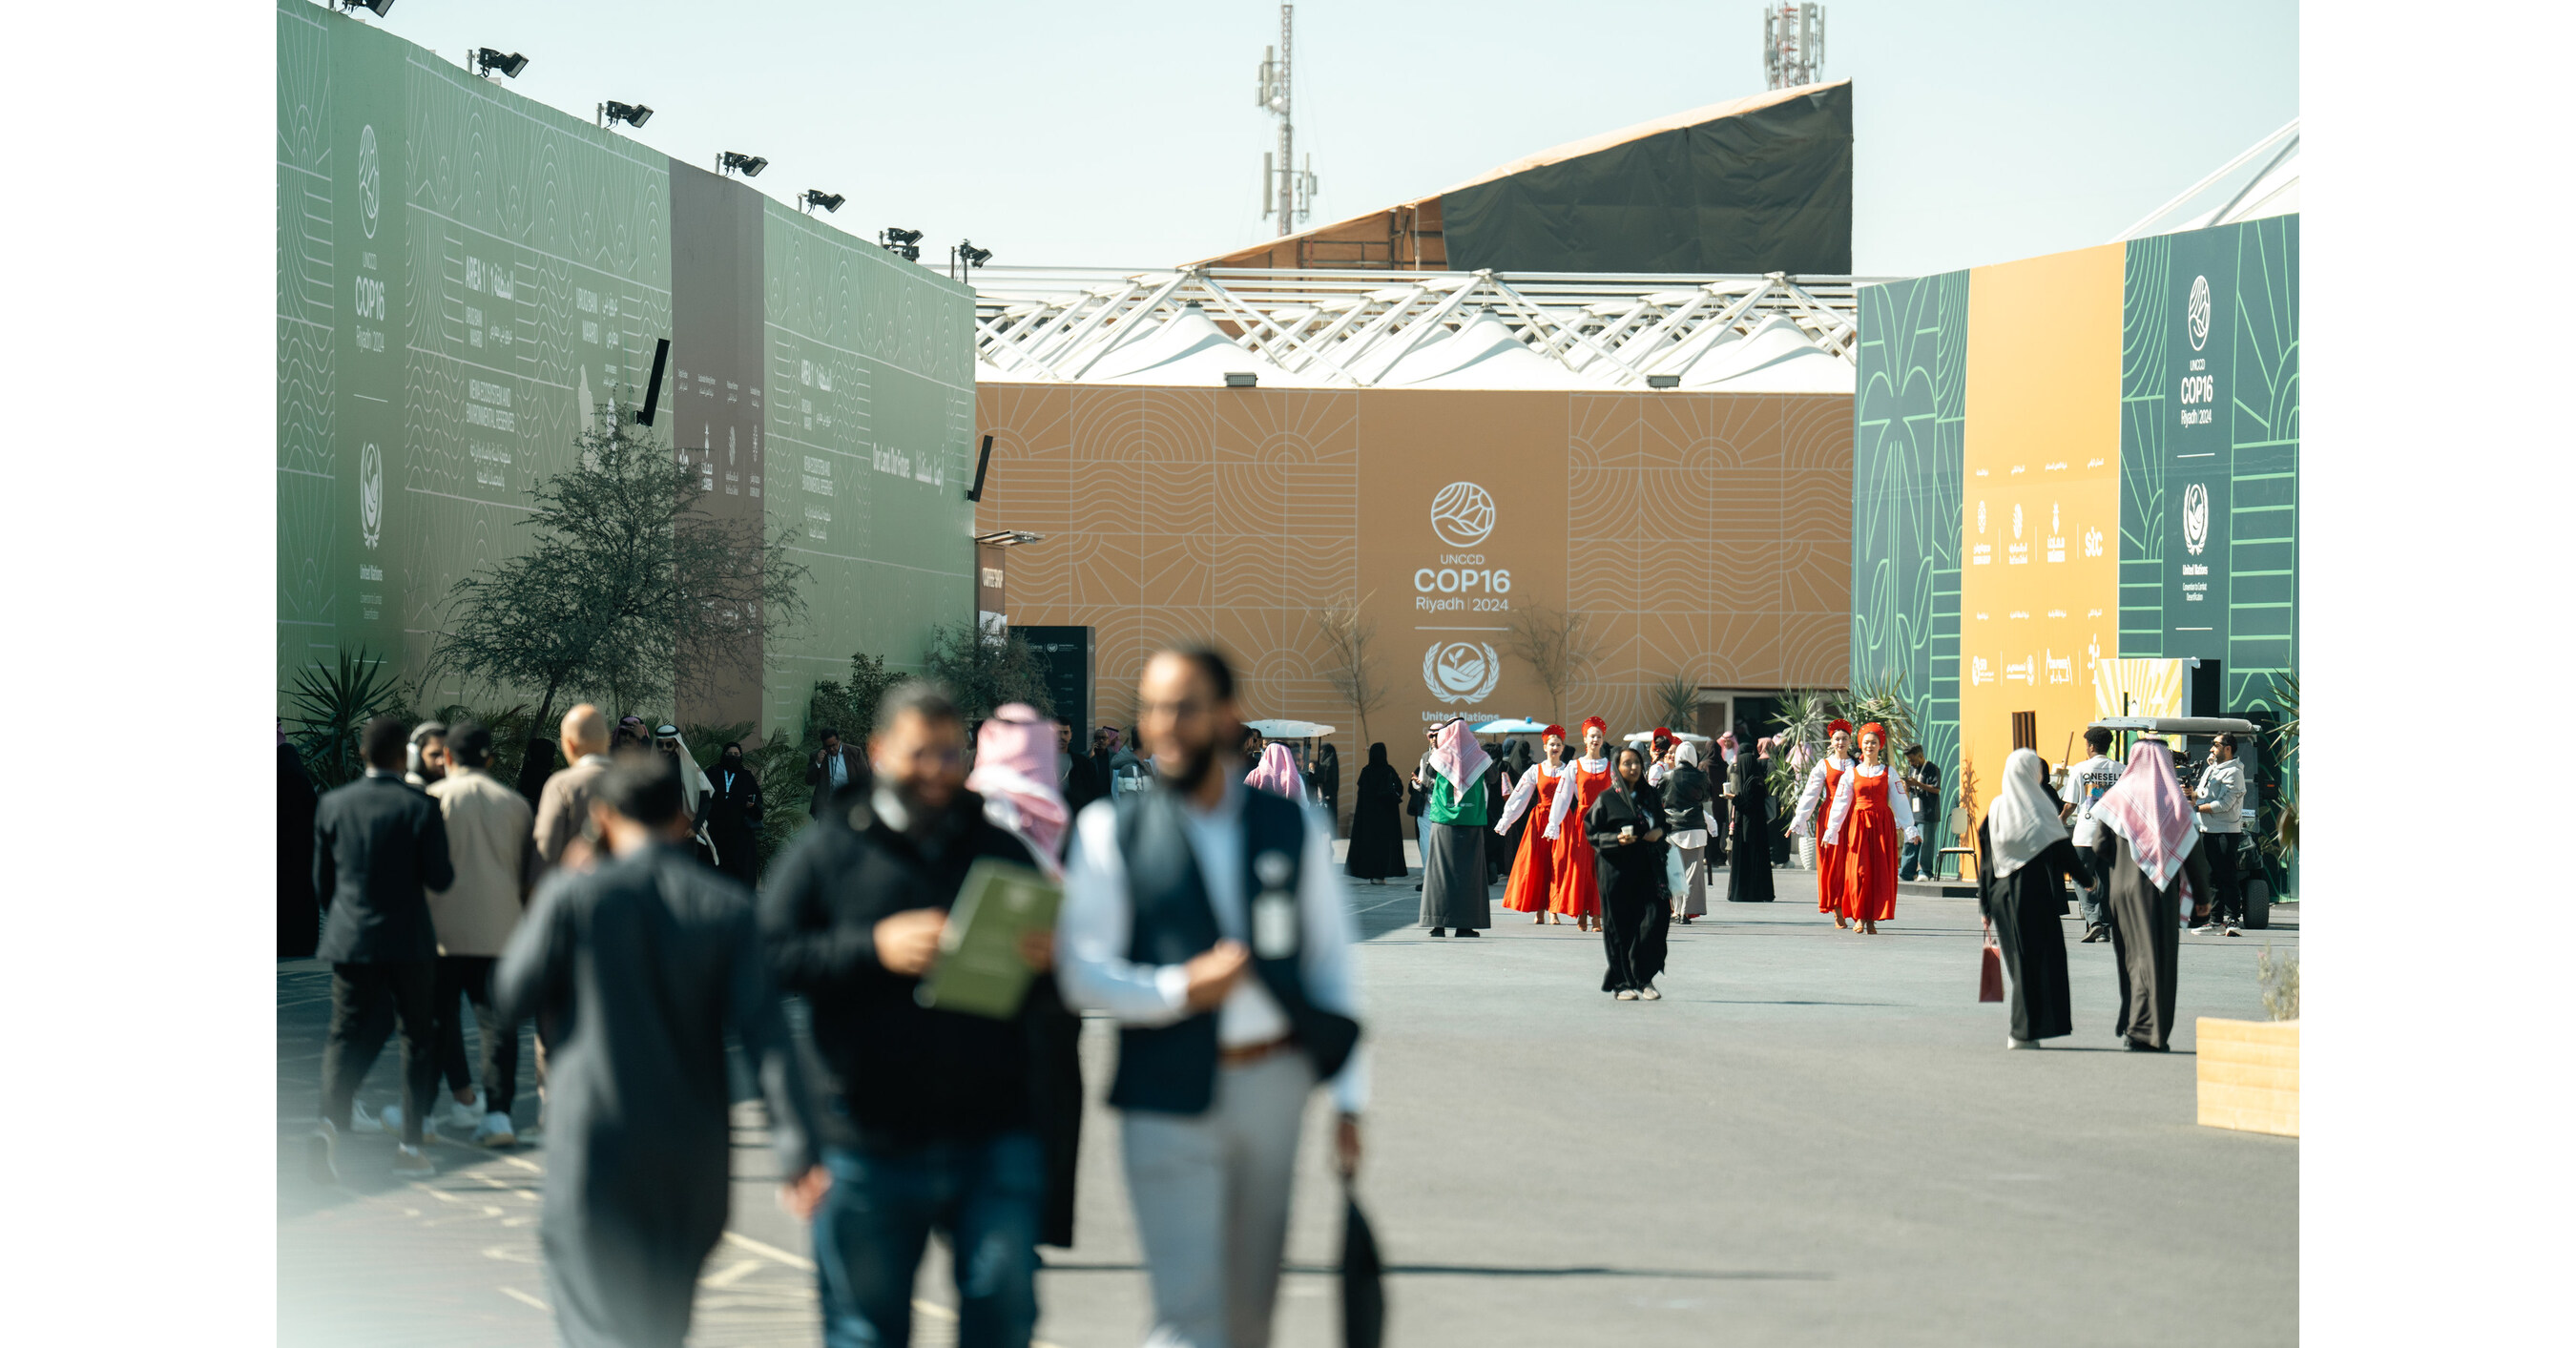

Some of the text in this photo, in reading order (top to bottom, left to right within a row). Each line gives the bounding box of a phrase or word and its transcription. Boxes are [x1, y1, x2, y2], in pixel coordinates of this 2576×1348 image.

[466, 254, 482, 292] AREA
[355, 275, 385, 321] COP16
[356, 324, 385, 353] Riyadh 2024
[2190, 358, 2206, 371] UNCCD
[2181, 374, 2213, 404] COP16
[2181, 408, 2212, 427] Riyadh 2024
[2085, 527, 2104, 557] stc
[1440, 553, 1485, 565] UNCCD
[2182, 564, 2194, 575] United
[1414, 568, 1511, 593] COP16
[1416, 596, 1509, 613] Riyadh 2024
[1422, 711, 1500, 722] United Nations
